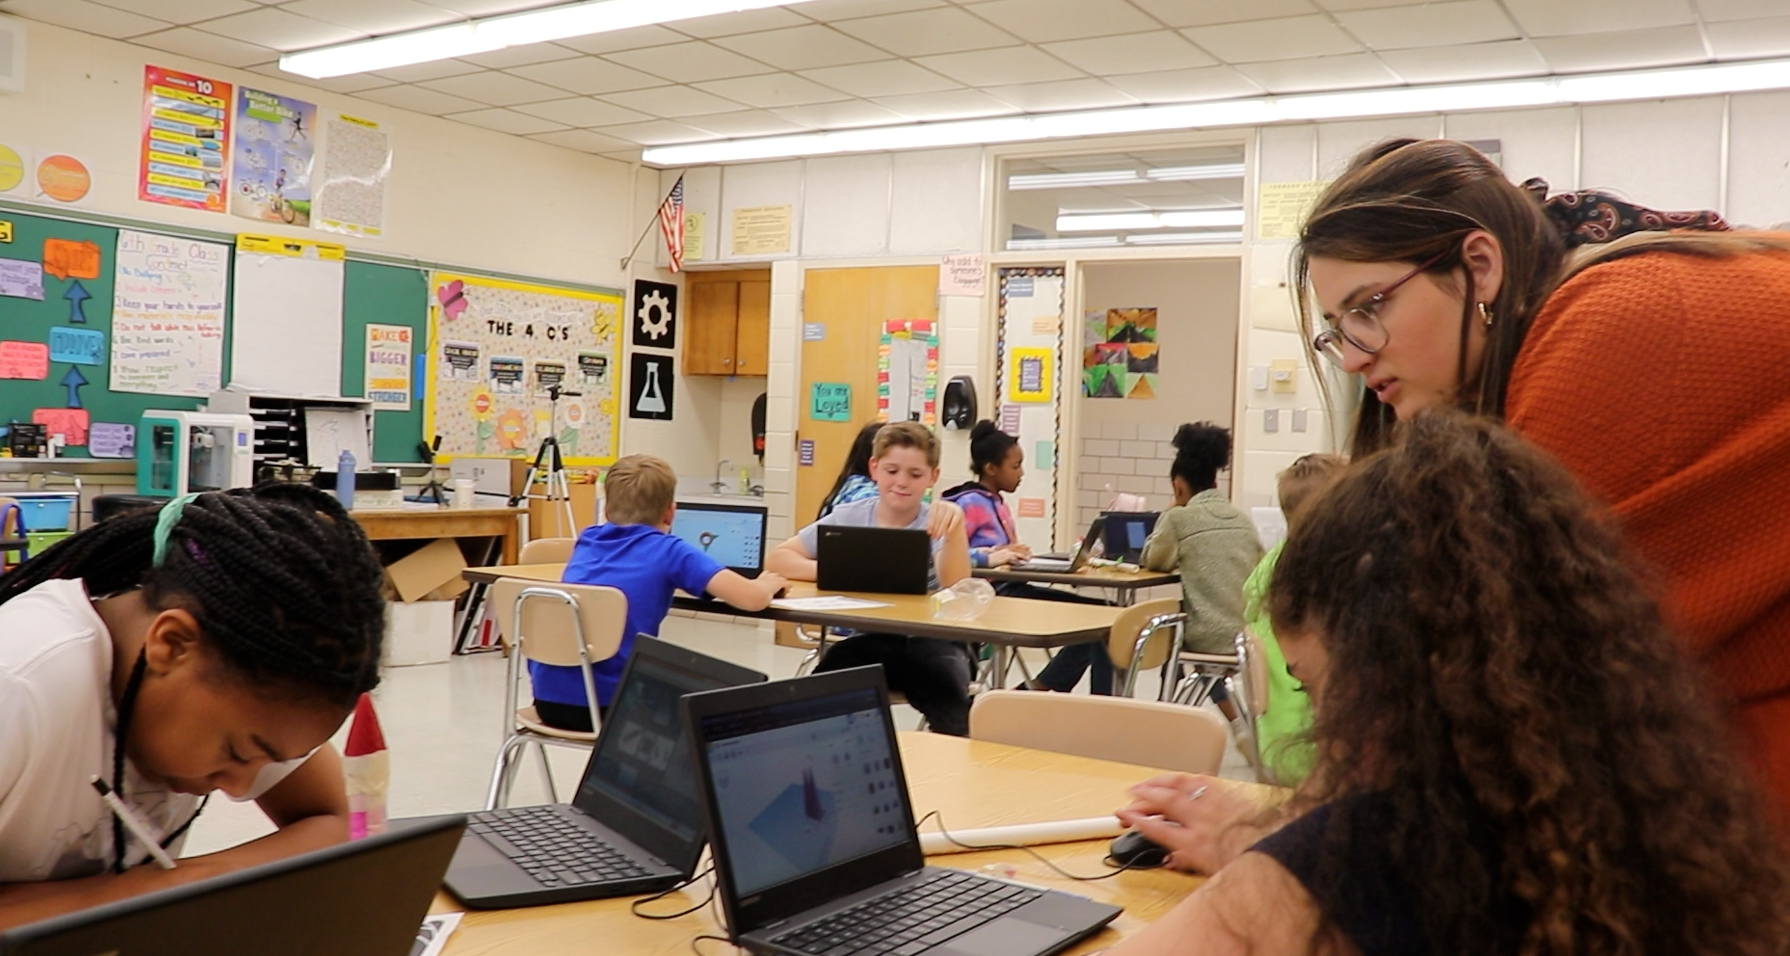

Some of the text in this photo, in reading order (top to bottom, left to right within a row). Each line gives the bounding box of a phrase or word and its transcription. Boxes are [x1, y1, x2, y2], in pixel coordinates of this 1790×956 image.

[196, 80, 213, 94] 10
[250, 99, 294, 119] Better Bike
[120, 231, 144, 251] 6th
[188, 243, 219, 261] Class
[957, 256, 971, 266] add
[123, 298, 141, 309] Keep
[163, 300, 185, 310] hands
[487, 319, 513, 336] THE
[525, 324, 534, 337] 4
[369, 351, 407, 366] BIGGER
[814, 383, 832, 398] You
[815, 396, 849, 413] Loved
